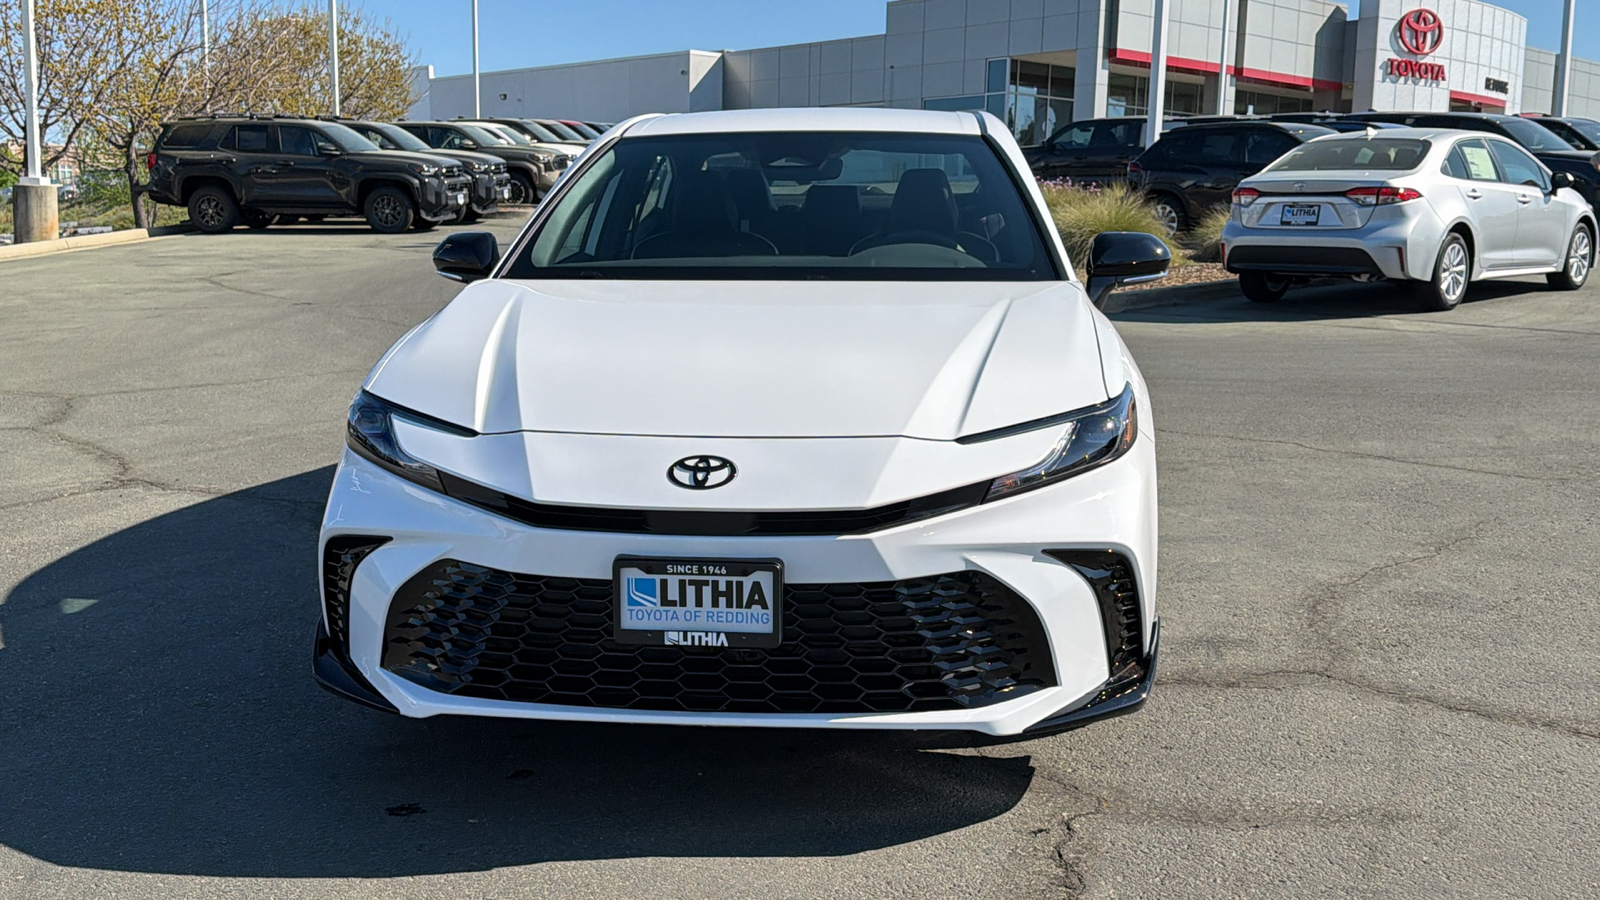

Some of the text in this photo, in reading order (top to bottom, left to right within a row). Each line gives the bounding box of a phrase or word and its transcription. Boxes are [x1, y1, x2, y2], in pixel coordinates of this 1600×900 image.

[1387, 58, 1446, 81] TOYOTA
[1291, 208, 1317, 216] LITHIA
[666, 564, 727, 575] SINCE 1946
[659, 578, 770, 610] LITHIA
[627, 608, 770, 625] TOYOTA OF REDDING
[679, 631, 729, 647] LITHIA
